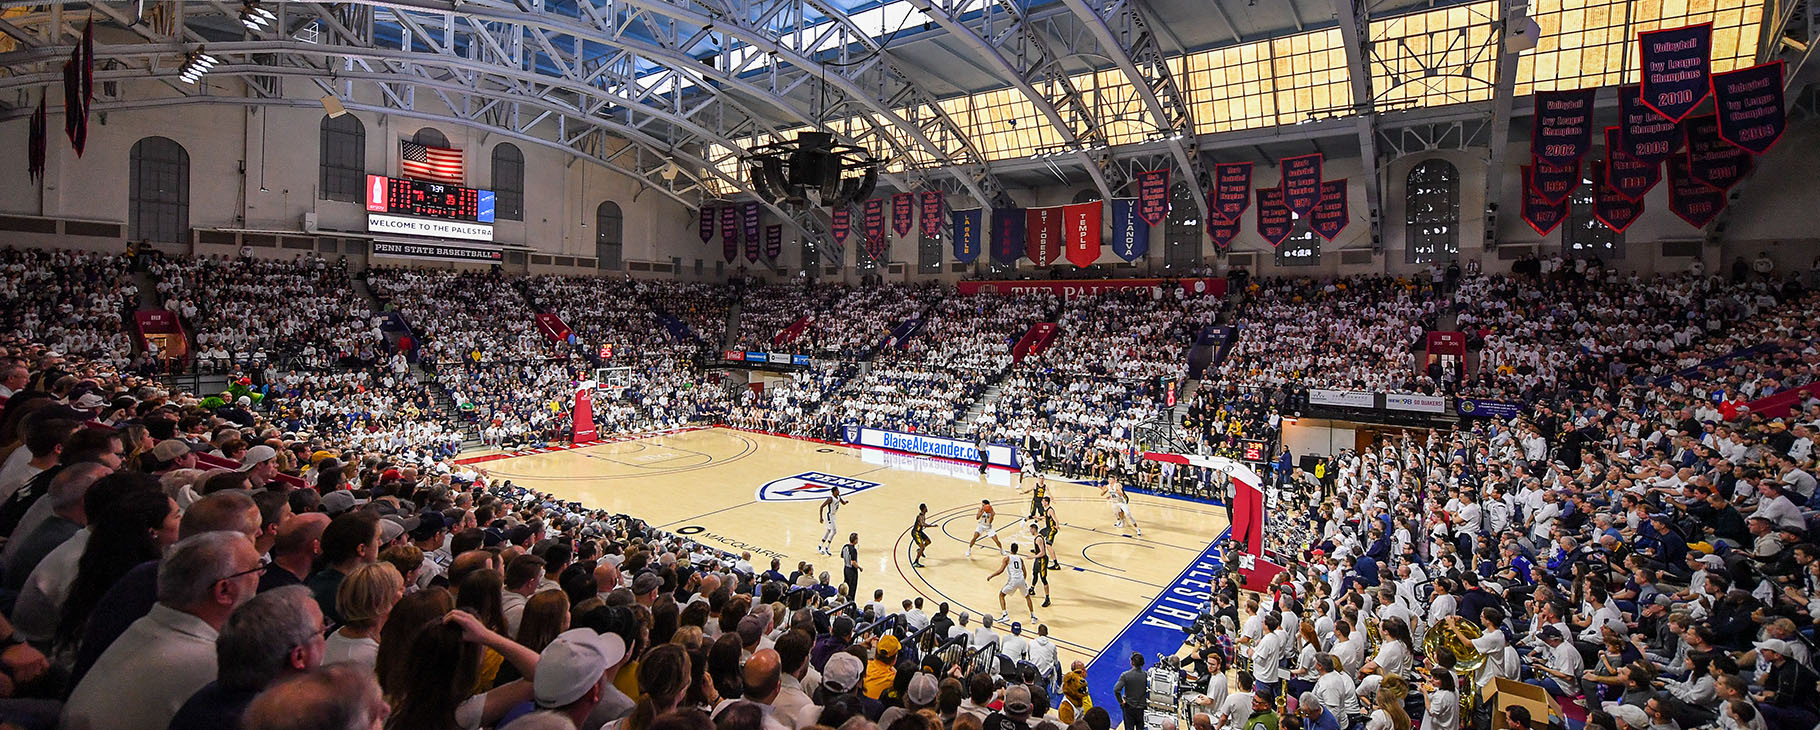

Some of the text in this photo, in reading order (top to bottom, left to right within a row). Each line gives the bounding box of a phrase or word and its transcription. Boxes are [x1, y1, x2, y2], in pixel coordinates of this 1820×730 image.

[1653, 38, 1697, 53] Volleyball
[1650, 56, 1701, 71] Ivy League
[1651, 70, 1701, 84] Champions
[1547, 99, 1584, 110] Volleyball
[1658, 89, 1693, 106] 2010
[1542, 115, 1584, 126] Ivy League
[1629, 115, 1643, 124] Ivy
[1543, 127, 1582, 137] Champions
[1630, 122, 1675, 134] Champions
[1545, 143, 1576, 157] 2002
[1636, 141, 1669, 155] 2003
[370, 219, 417, 230] WELCOME
[433, 224, 449, 232] THE
[451, 226, 492, 236] PALESTRA
[1078, 213, 1088, 250] TEMPLE
[1124, 200, 1135, 256] VILLANOVA
[374, 243, 402, 252] PENN
[404, 245, 435, 255] STATE
[436, 248, 492, 259] BASKETBALL
[1247, 449, 1260, 460] 25
[806, 473, 868, 489] PENN
[701, 532, 789, 559] MACQUARIE
[1013, 560, 1019, 569] 0
